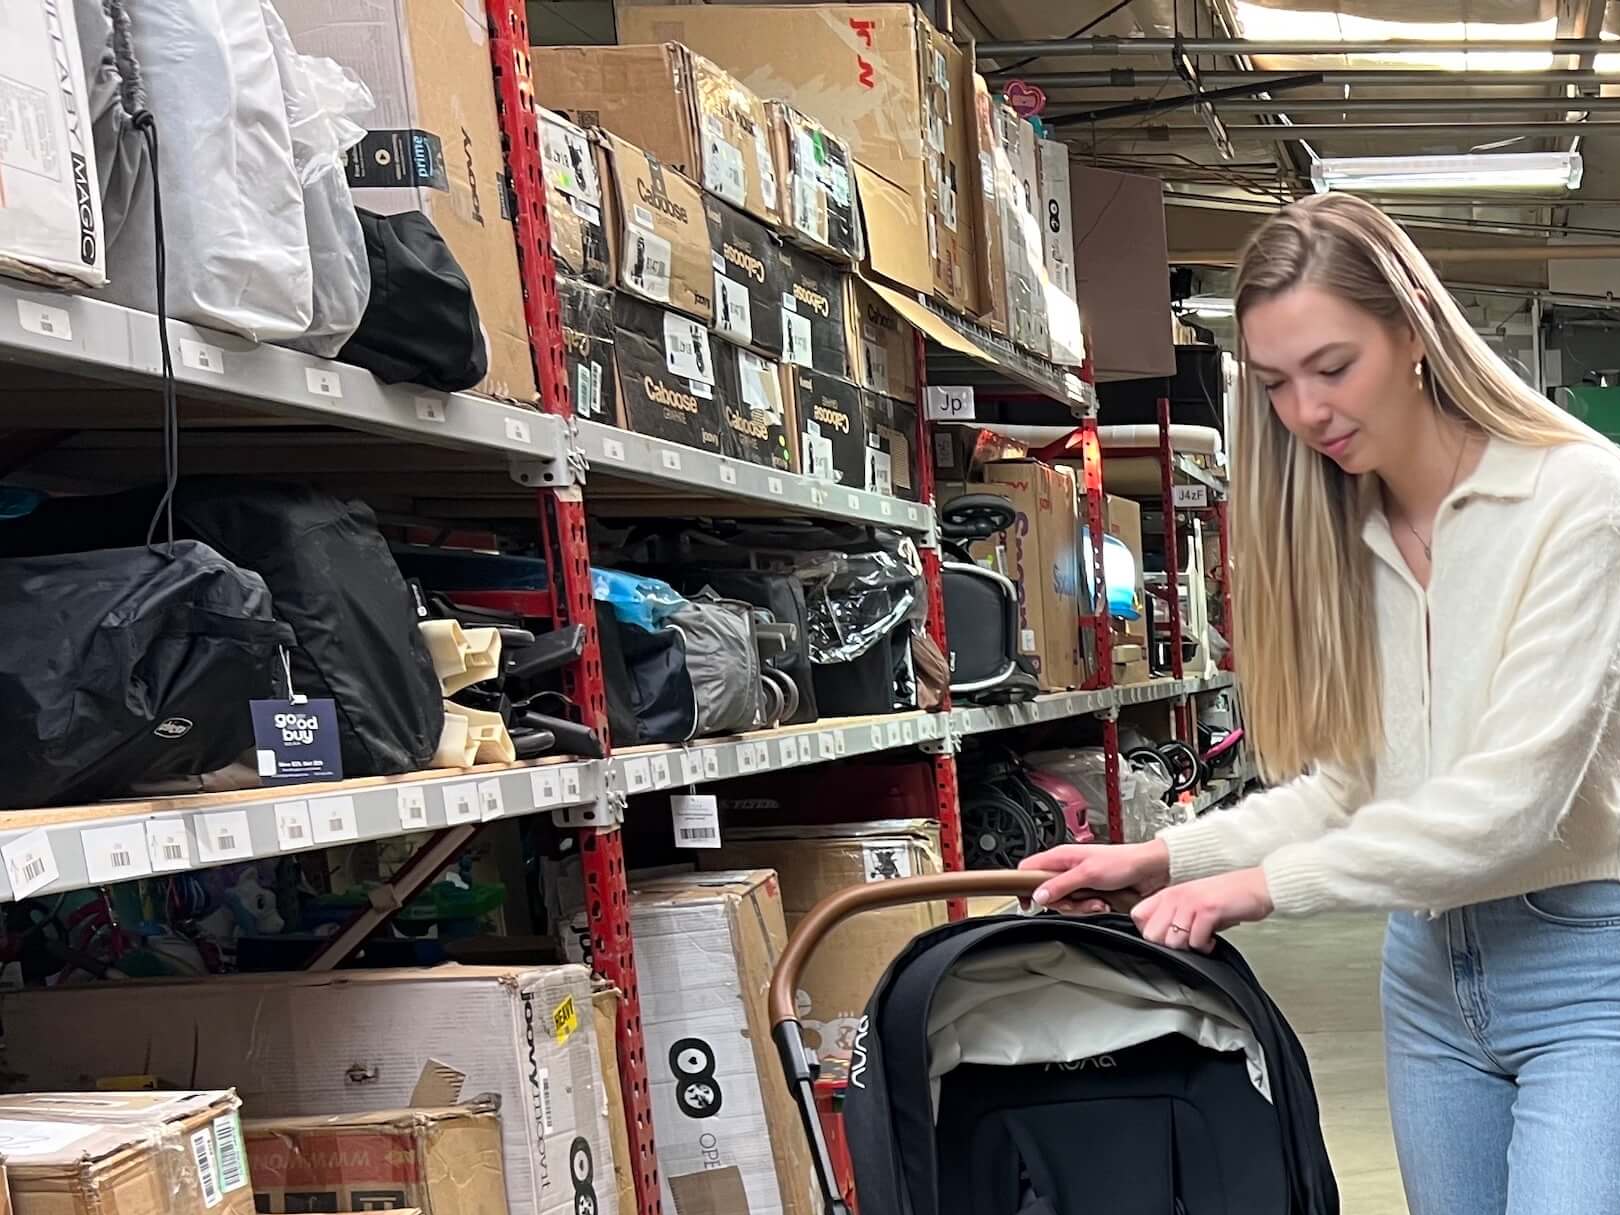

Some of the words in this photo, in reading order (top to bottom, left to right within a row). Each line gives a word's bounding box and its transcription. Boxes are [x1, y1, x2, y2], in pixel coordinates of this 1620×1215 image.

[412, 135, 430, 178] prime
[73, 155, 95, 260] MAGIC
[645, 376, 699, 413] Caboose
[940, 393, 962, 415] Jp
[274, 713, 318, 731] good
[282, 729, 314, 745] buy
[554, 998, 575, 1029] HEAVY
[521, 991, 540, 1089] joovy
[533, 1091, 551, 1189] moovit
[699, 1132, 721, 1169] OPE
